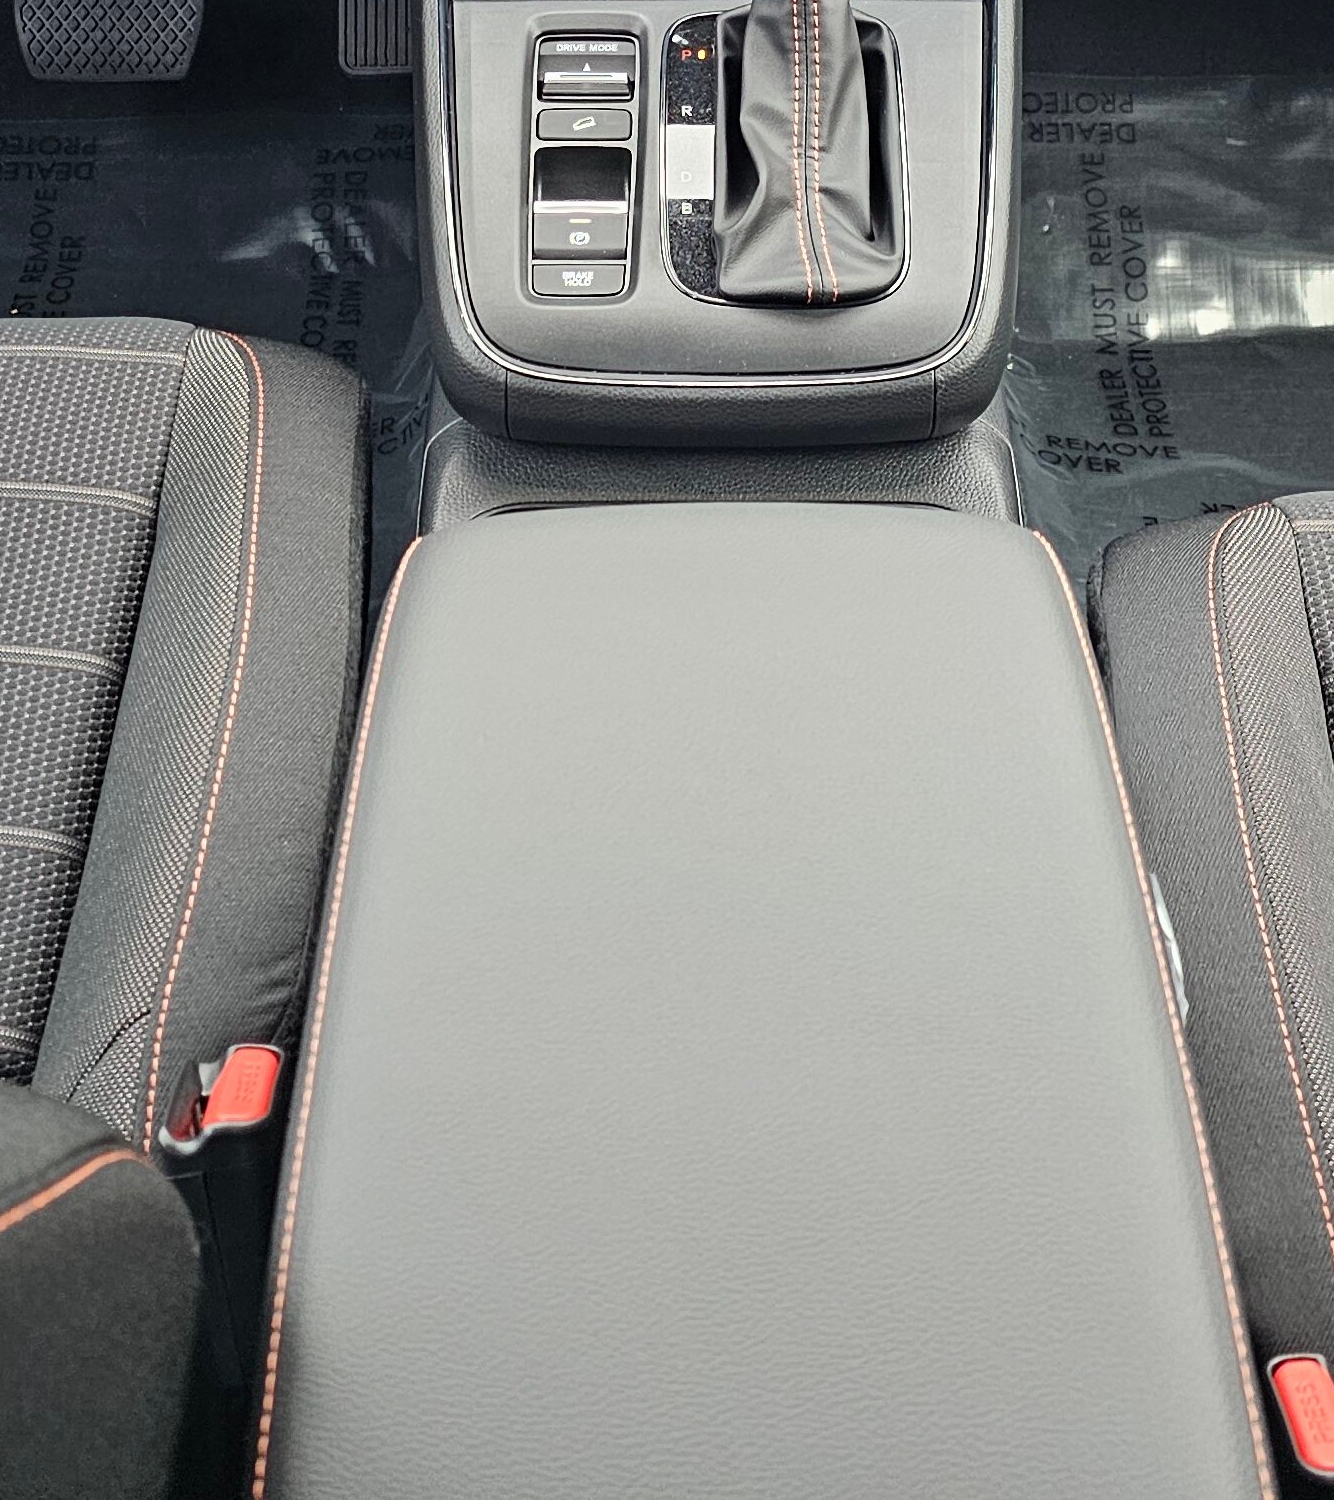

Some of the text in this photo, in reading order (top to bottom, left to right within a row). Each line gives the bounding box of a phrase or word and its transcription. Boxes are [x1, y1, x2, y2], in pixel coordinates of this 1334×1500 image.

[556, 43, 618, 52] DRIVE MODE
[681, 49, 692, 60] P
[681, 105, 693, 116] R
[1029, 122, 1136, 145] DEALER
[680, 171, 693, 182] D
[681, 202, 693, 215] B
[564, 278, 592, 286] HOLD
[1079, 152, 1138, 438] DEALER MUST REMOVE
[1119, 203, 1172, 439] PROTECTIVE COVER
[1045, 435, 1181, 461] REMOVE
